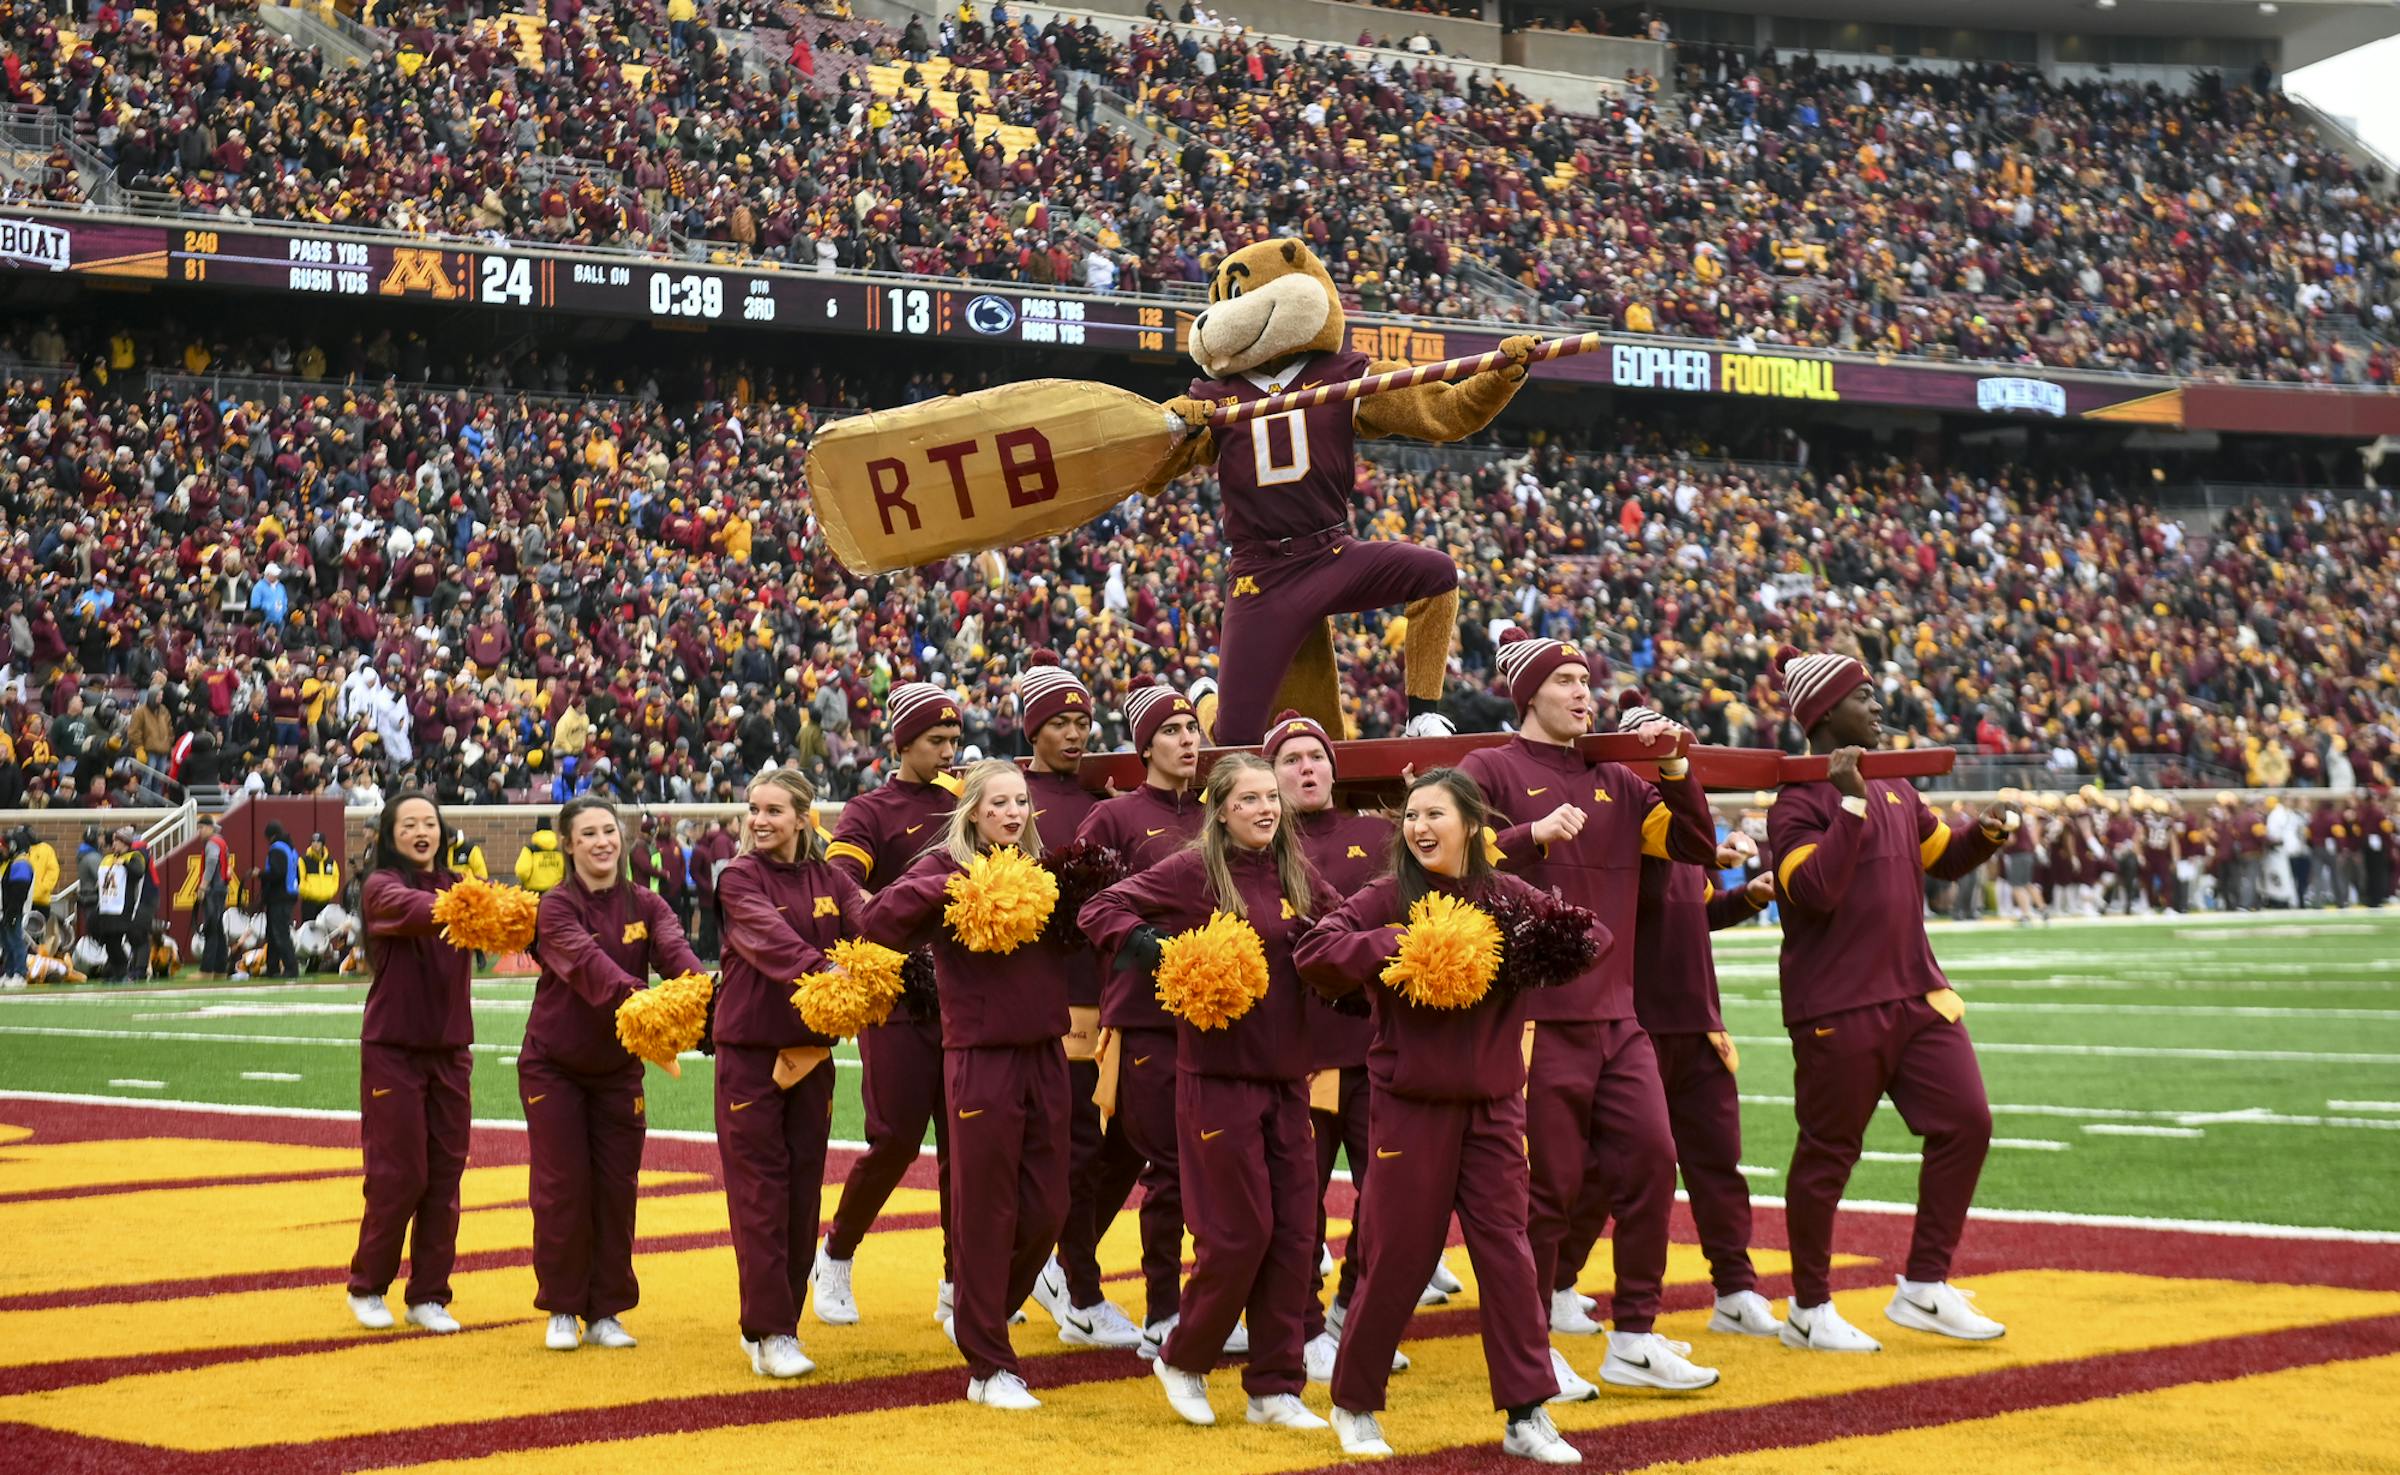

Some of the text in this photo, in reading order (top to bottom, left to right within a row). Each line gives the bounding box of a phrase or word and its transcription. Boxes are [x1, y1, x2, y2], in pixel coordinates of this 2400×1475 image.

[1, 224, 64, 260] BOAT
[184, 230, 219, 254] 240
[289, 238, 369, 266] PASS YDS
[184, 258, 207, 281] 81
[289, 267, 369, 295] RUSH YDS
[379, 247, 456, 299] M
[481, 255, 533, 305] 24
[573, 264, 630, 286] BALL ON
[649, 272, 724, 318] 0:39
[743, 295, 775, 321] 3RD
[888, 288, 930, 334] 13
[1021, 298, 1085, 321] PASS YDS
[1021, 321, 1085, 345] RUSH YDS
[1612, 344, 1841, 402] GOPHER FOOTBALL
[866, 426, 1060, 536] RTB
